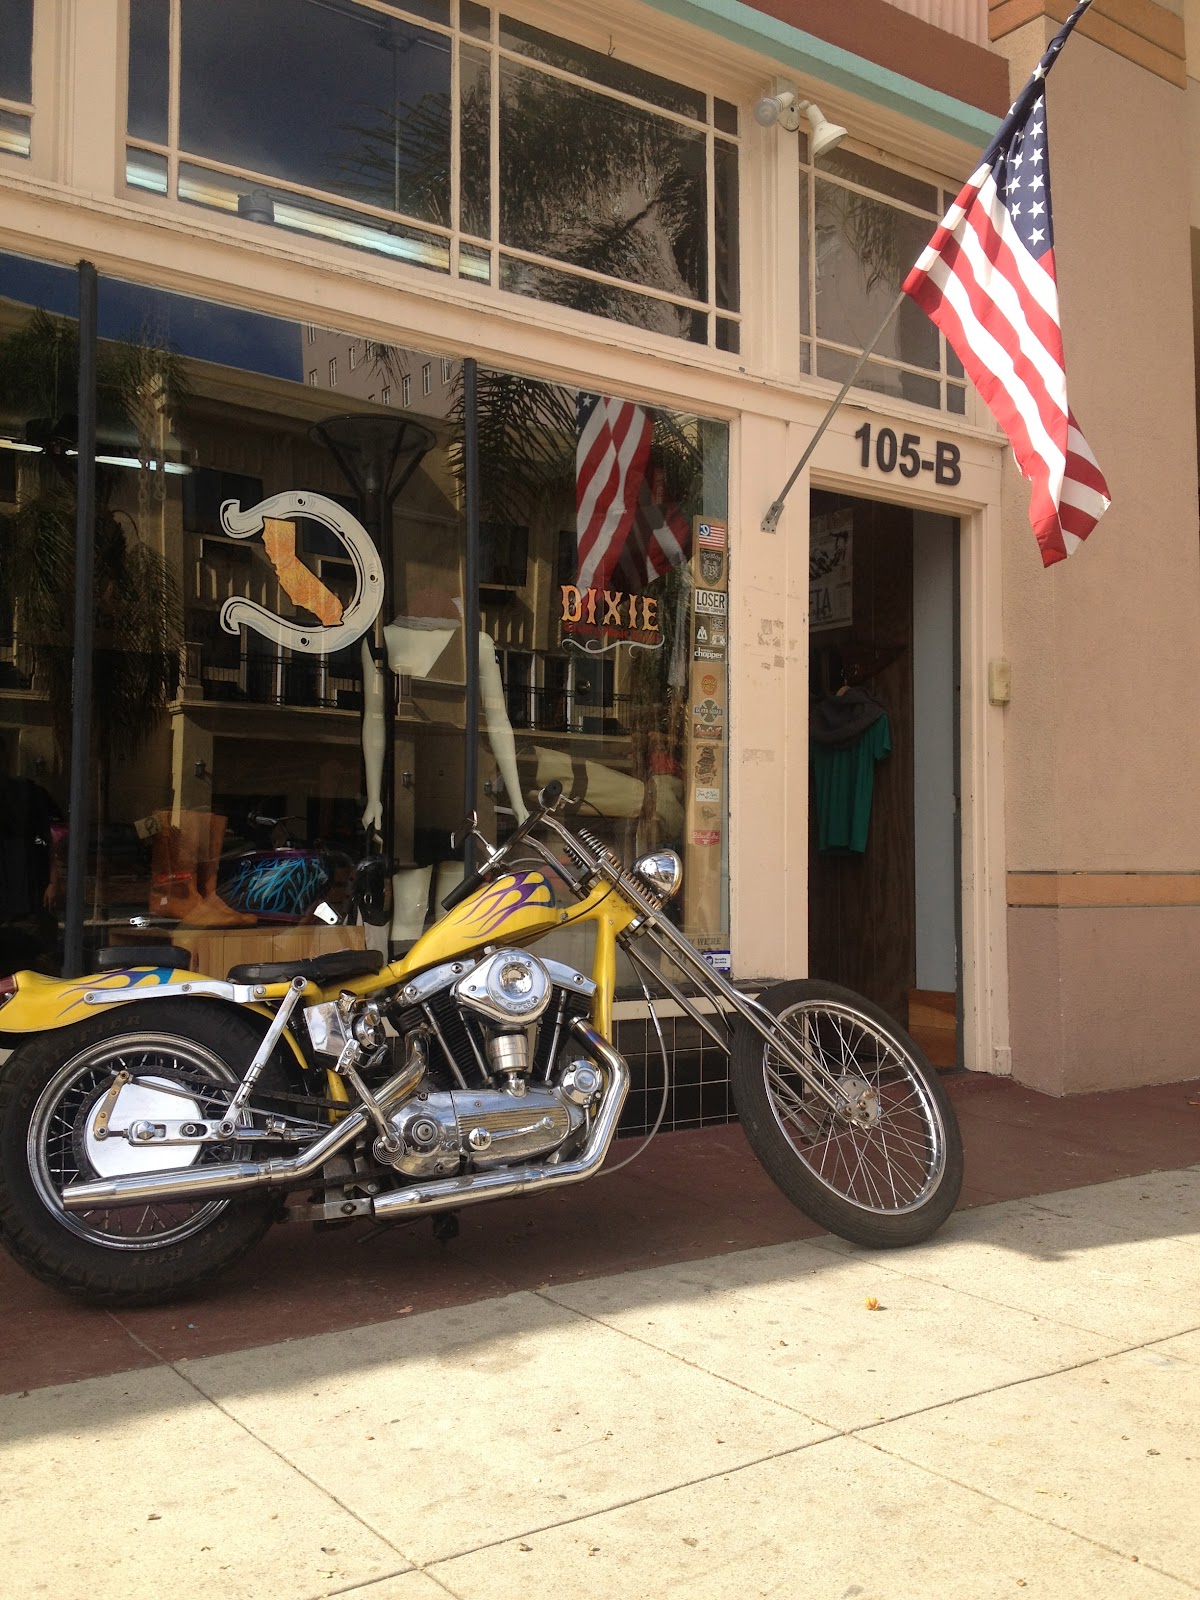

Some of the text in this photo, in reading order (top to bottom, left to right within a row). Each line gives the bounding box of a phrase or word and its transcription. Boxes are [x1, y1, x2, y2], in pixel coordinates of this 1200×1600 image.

[855, 422, 961, 486] 105-B
[560, 584, 660, 632] DIXIE
[696, 590, 725, 609] LOSER
[694, 646, 724, 659] chopper
